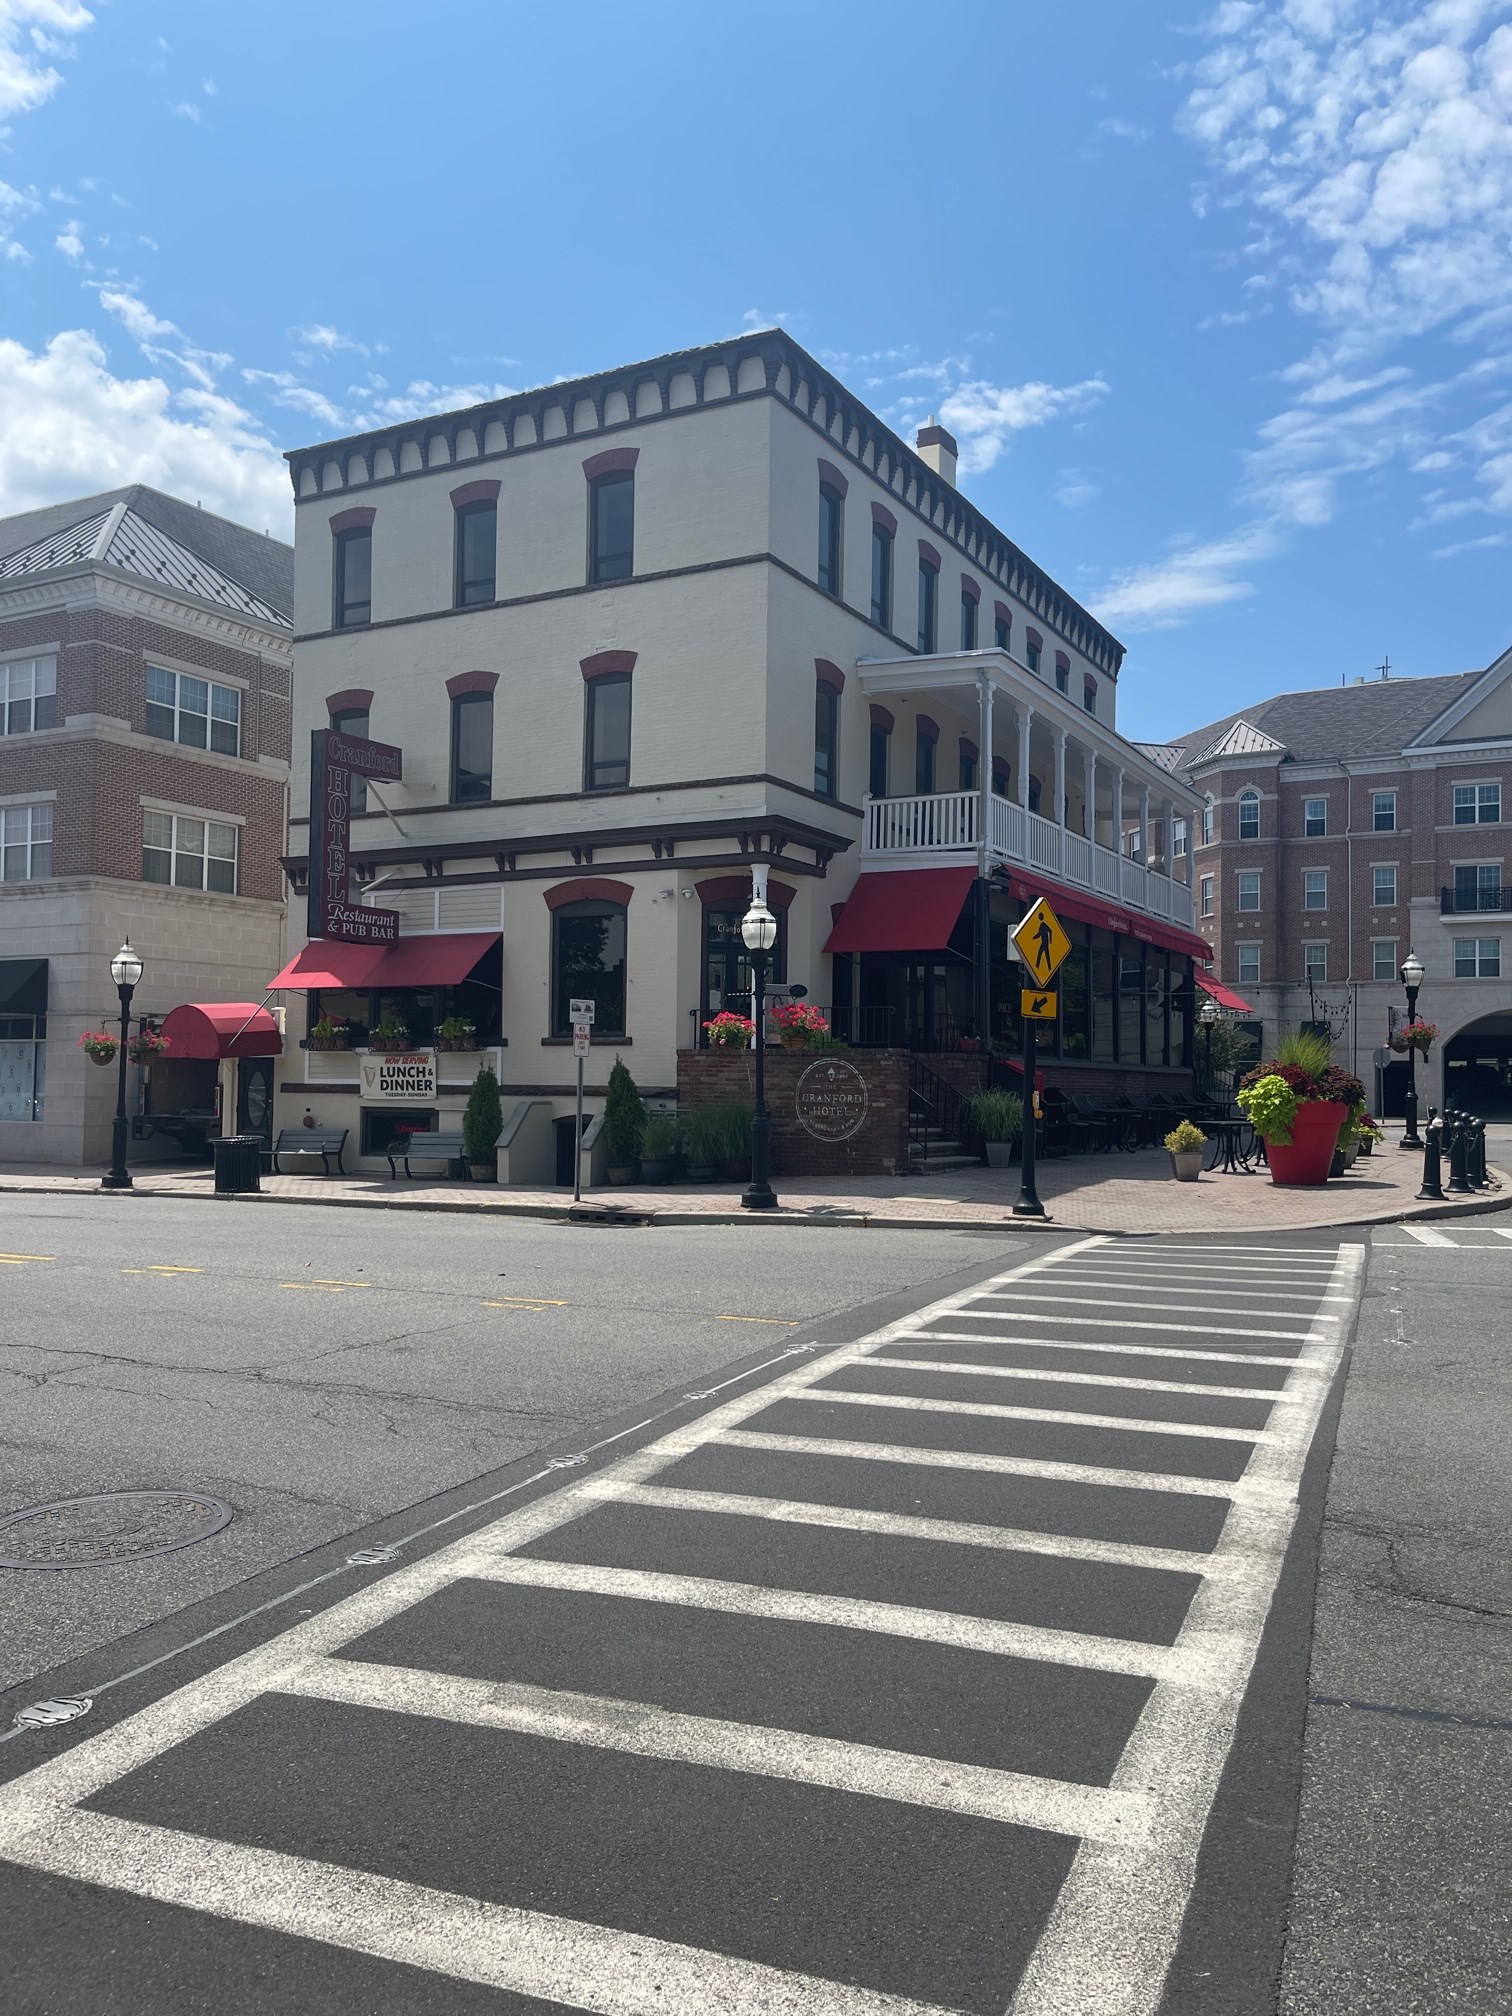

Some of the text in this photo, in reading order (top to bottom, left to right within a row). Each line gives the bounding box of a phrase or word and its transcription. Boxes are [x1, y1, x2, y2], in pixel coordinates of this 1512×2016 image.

[328, 736, 400, 775] Cranford
[328, 765, 348, 902] HOTEL
[327, 903, 395, 926] Restaurant
[327, 920, 395, 940] & PUB BAR
[717, 923, 741, 935] Cranfo
[384, 1056, 429, 1065] NOW SERVING
[380, 1066, 434, 1078] LUNCH &
[380, 1079, 433, 1091] DINNER
[802, 1093, 862, 1104] CRANFORD
[813, 1106, 852, 1117] HOTEL
